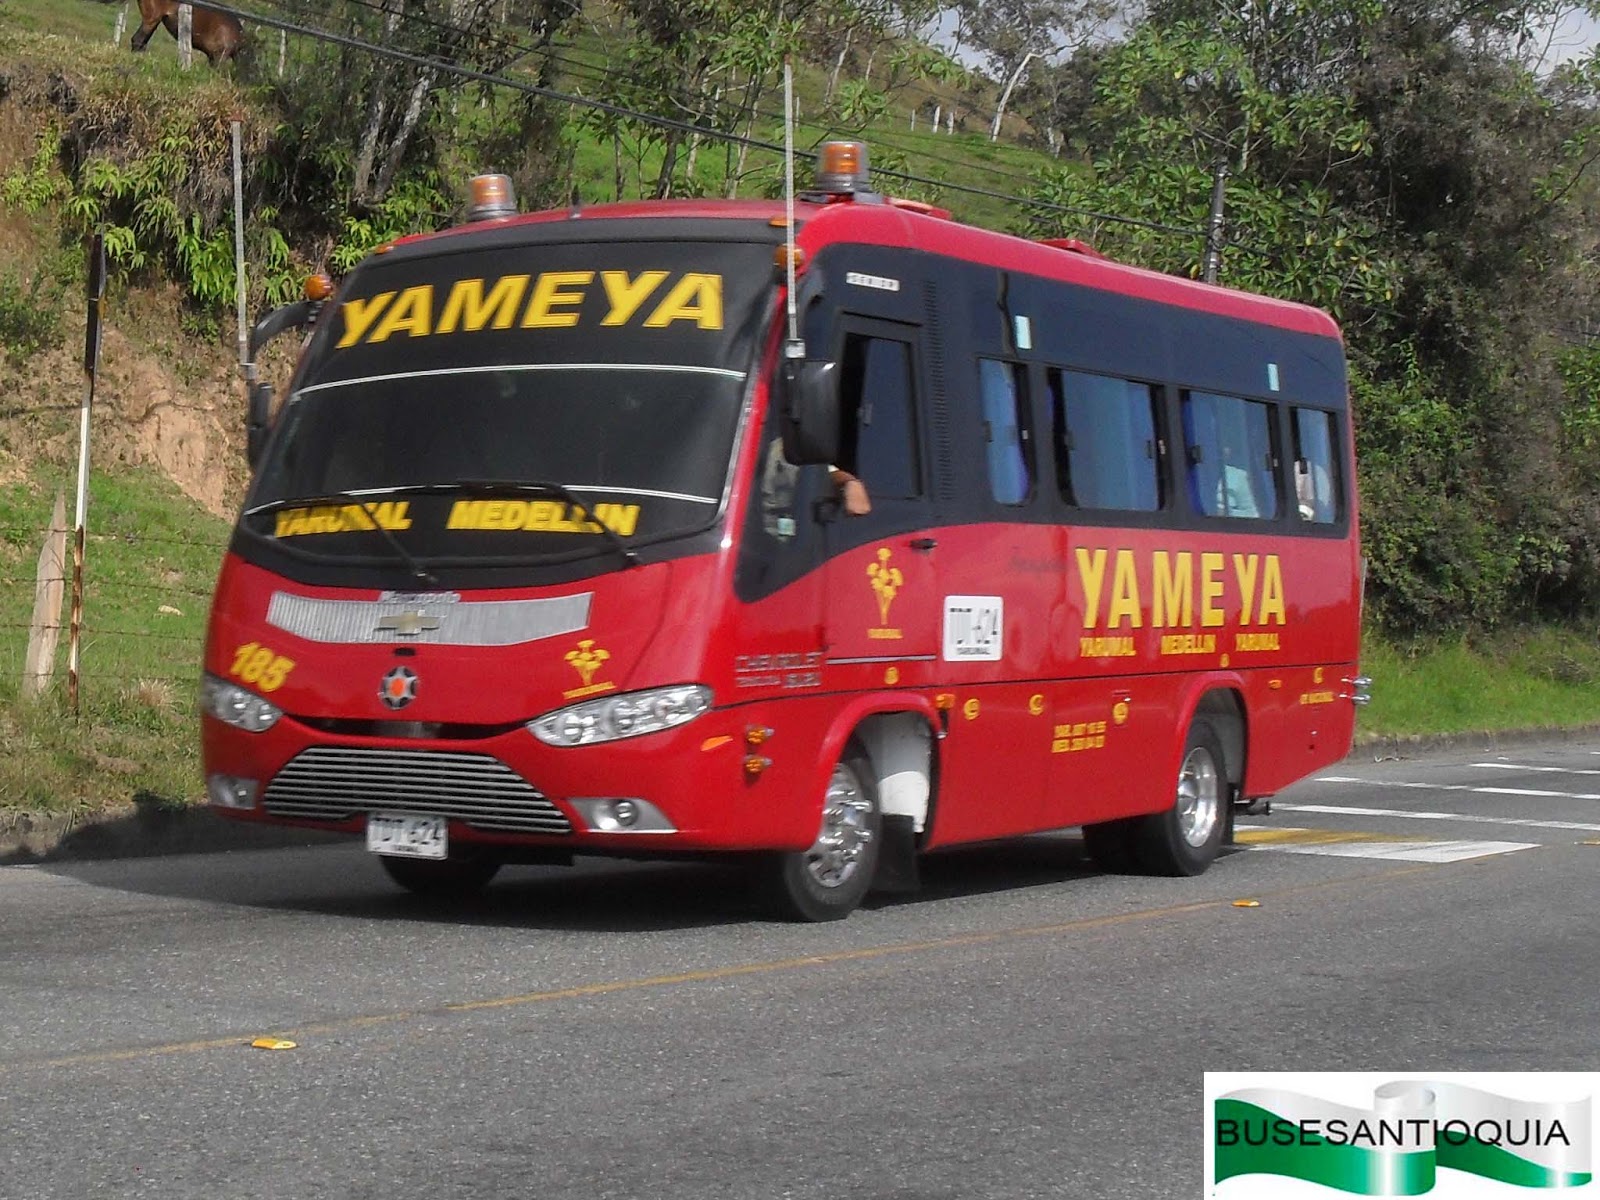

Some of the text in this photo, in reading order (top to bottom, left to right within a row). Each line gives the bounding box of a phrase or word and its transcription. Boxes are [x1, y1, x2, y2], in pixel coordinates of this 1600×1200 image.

[335, 270, 724, 349] YAMEYA
[1075, 548, 1287, 628] YAMEYA
[230, 642, 296, 693] 185
